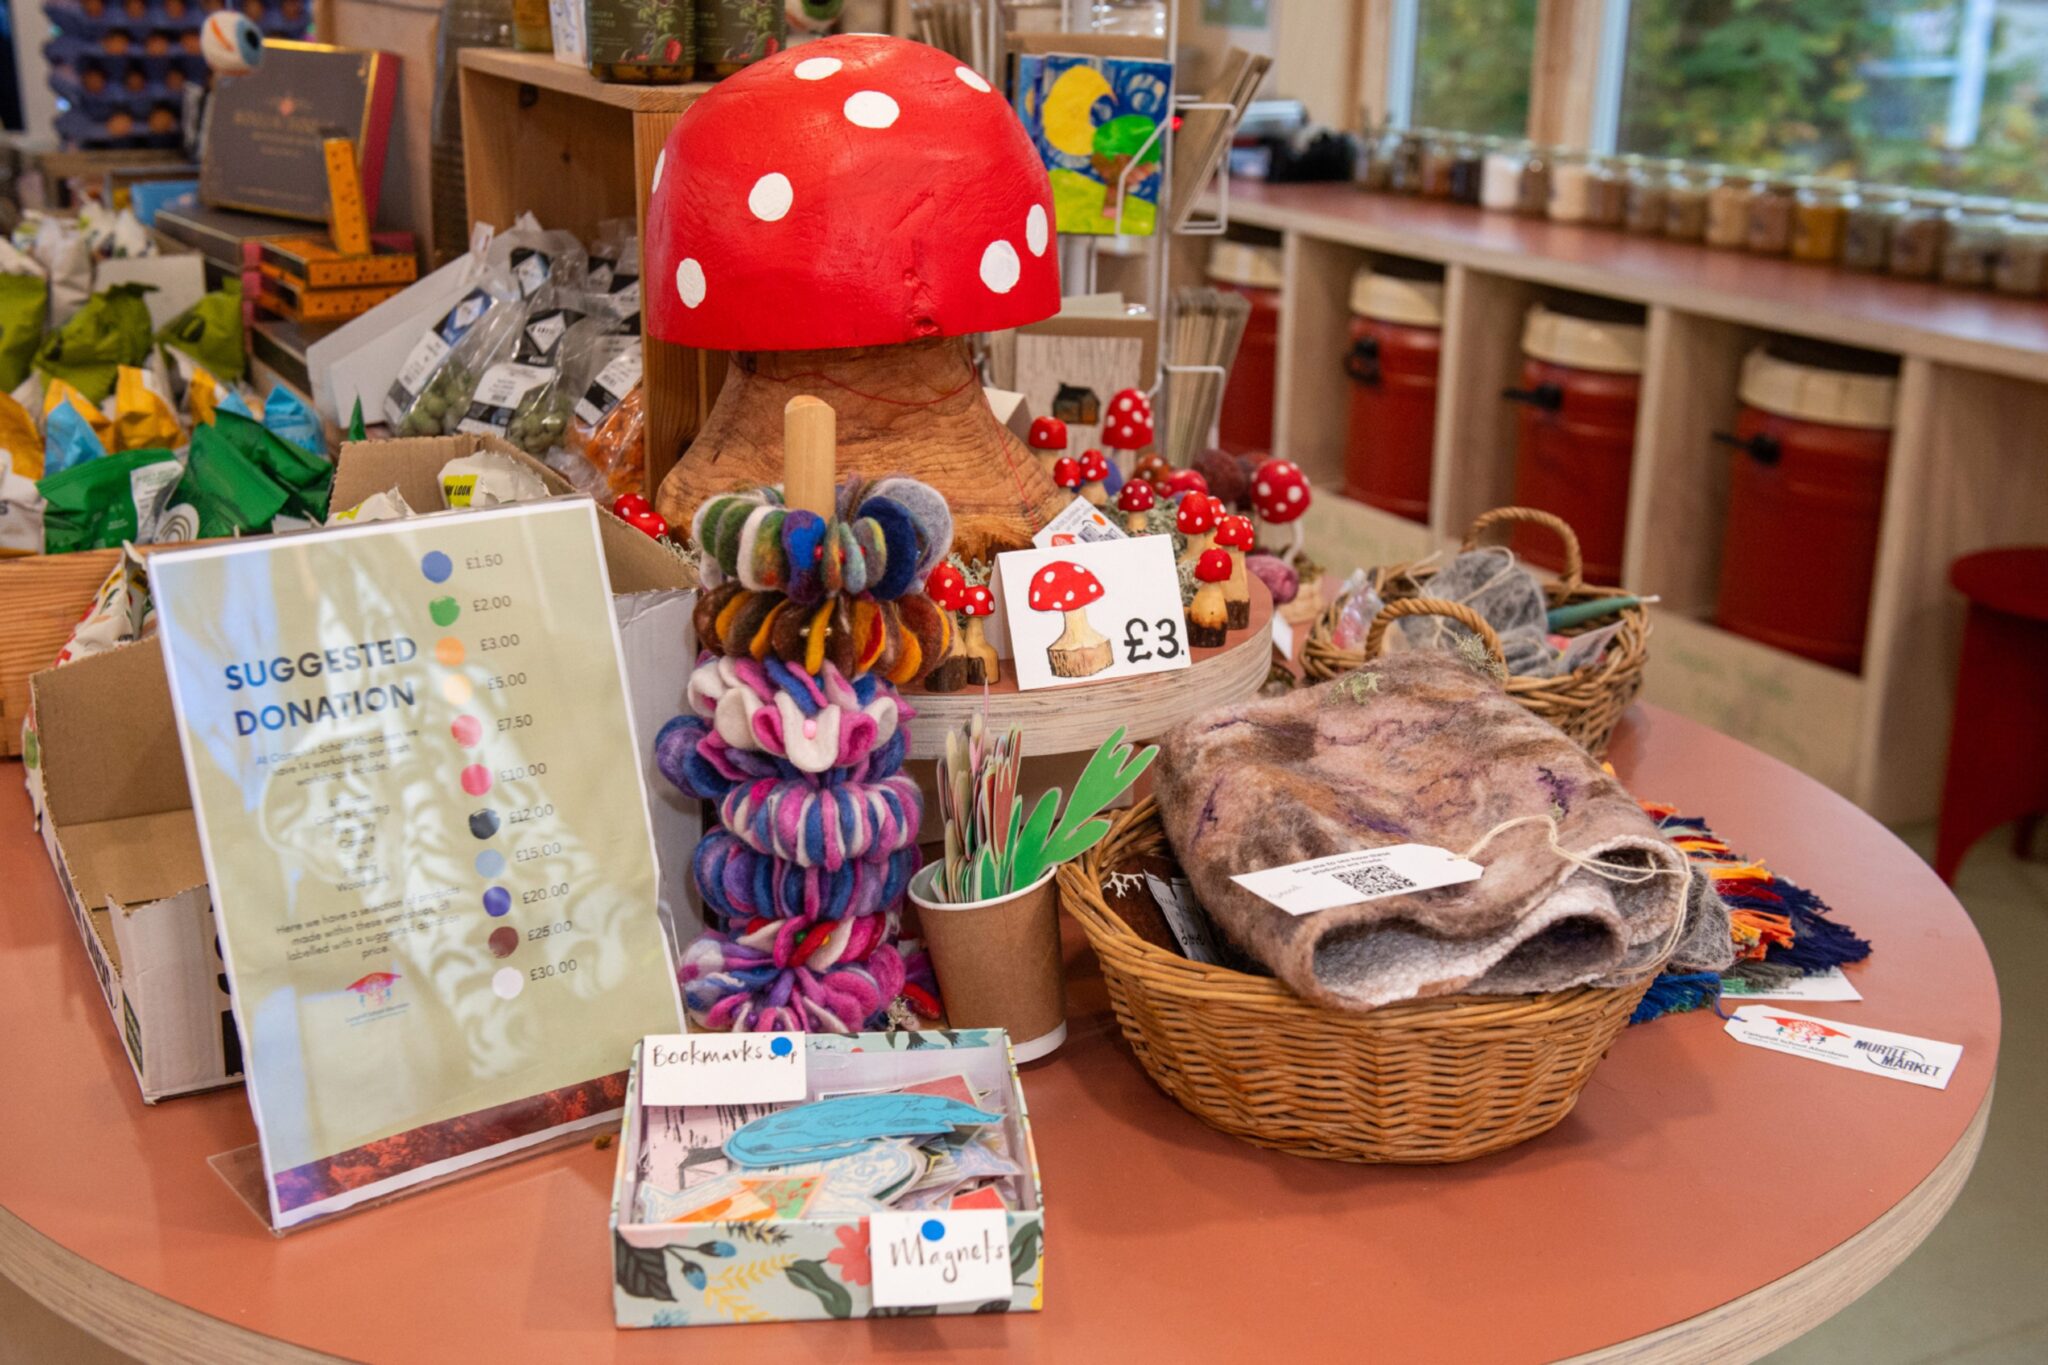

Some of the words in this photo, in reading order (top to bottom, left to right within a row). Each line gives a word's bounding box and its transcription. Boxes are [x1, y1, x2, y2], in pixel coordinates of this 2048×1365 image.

[453, 485, 472, 496] LOOK
[466, 553, 503, 570] £1.50
[473, 595, 512, 612] £2.00
[480, 634, 520, 651] £3.00
[224, 637, 417, 691] SUGGESTED
[487, 672, 527, 690] £5.00
[234, 681, 416, 736] DONATION
[497, 714, 533, 732] £7.50
[501, 762, 547, 783] £10.00
[509, 803, 554, 824] £12.00
[516, 842, 562, 863] £15.00
[522, 883, 570, 904] £20.00
[276, 922, 302, 934] Here
[305, 919, 320, 928] we
[322, 912, 348, 924] have
[360, 899, 403, 916] selection
[292, 932, 321, 946] made
[325, 925, 353, 938] within
[355, 918, 382, 931] these
[527, 920, 573, 941] £25.00
[287, 944, 330, 961] labelled
[333, 937, 353, 950] with
[365, 923, 416, 943] suggested
[529, 959, 577, 982] £30.00
[653, 1039, 763, 1067] Bookmarks
[1853, 1040, 1909, 1058] MURTLE
[1881, 1055, 1942, 1077] MARKET
[890, 1228, 1005, 1284] Magnets
